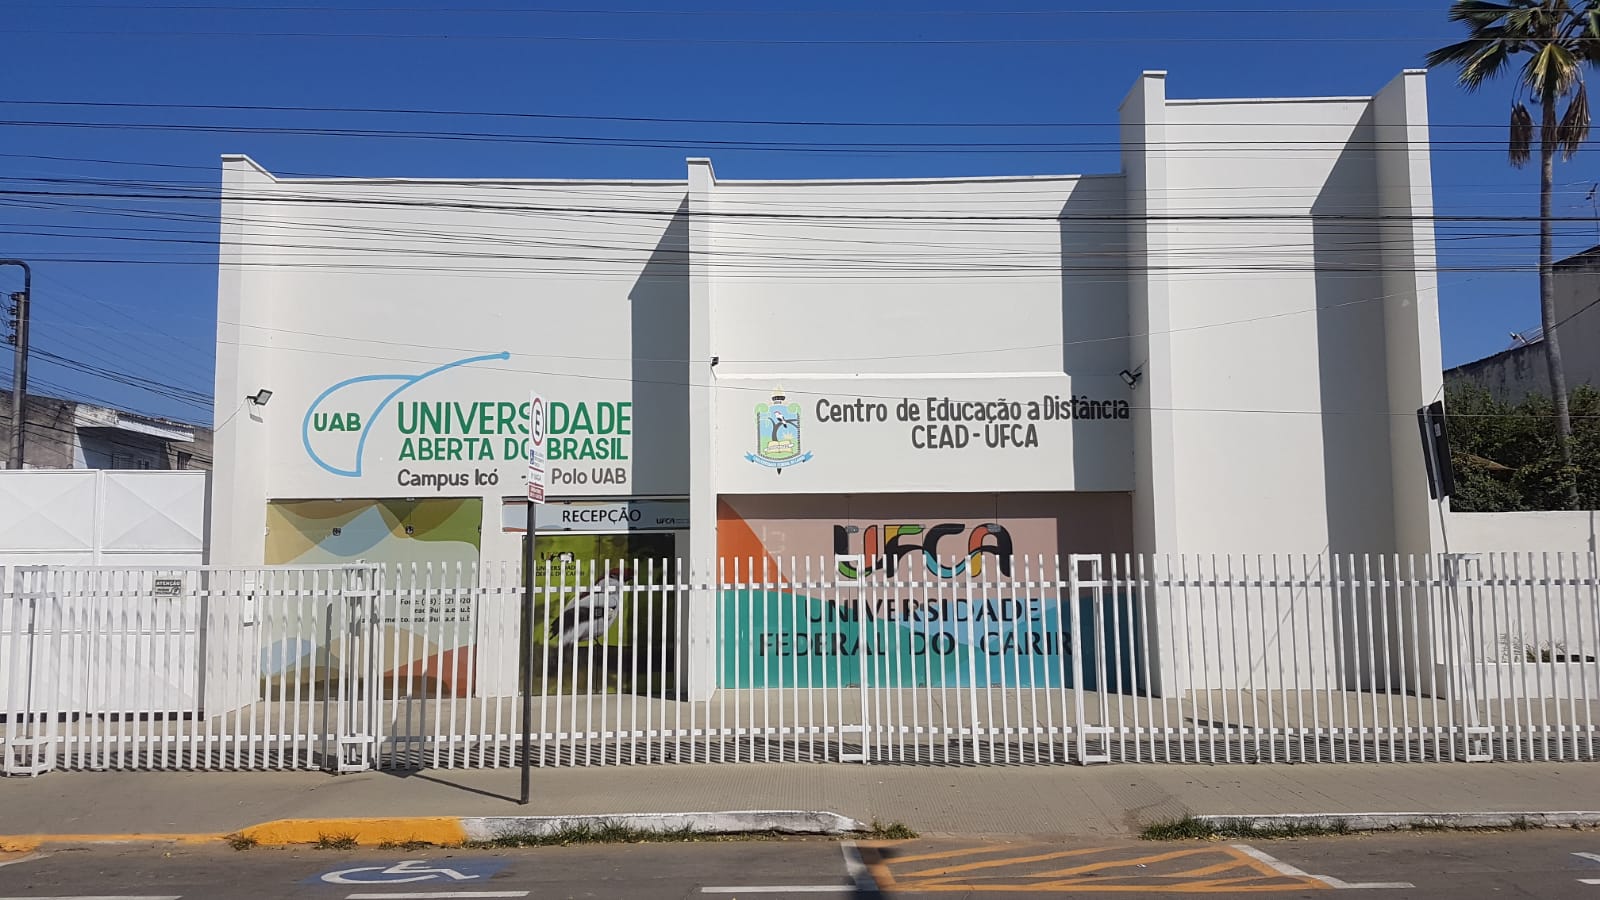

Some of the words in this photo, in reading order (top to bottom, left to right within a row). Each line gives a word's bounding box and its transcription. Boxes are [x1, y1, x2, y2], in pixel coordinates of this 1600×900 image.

[815, 399, 887, 422] Centro
[896, 398, 920, 421] de
[926, 397, 1021, 423] Educação
[1027, 401, 1040, 420] a
[1043, 395, 1129, 420] Distância
[314, 412, 361, 431] UAB
[399, 437, 494, 460] ABERTA
[547, 437, 628, 460] BRASIL
[398, 469, 469, 491] Campus
[475, 468, 499, 486] Icó
[552, 468, 587, 485] Polo
[592, 468, 626, 484] UAB
[562, 507, 641, 524] RECEPÇÃO
[834, 523, 1013, 578] UFCA
[804, 598, 1040, 623] UNIVERSIDADE
[759, 632, 886, 657] FEDERAL
[909, 631, 956, 656] DO
[980, 631, 1073, 656] CARIR
